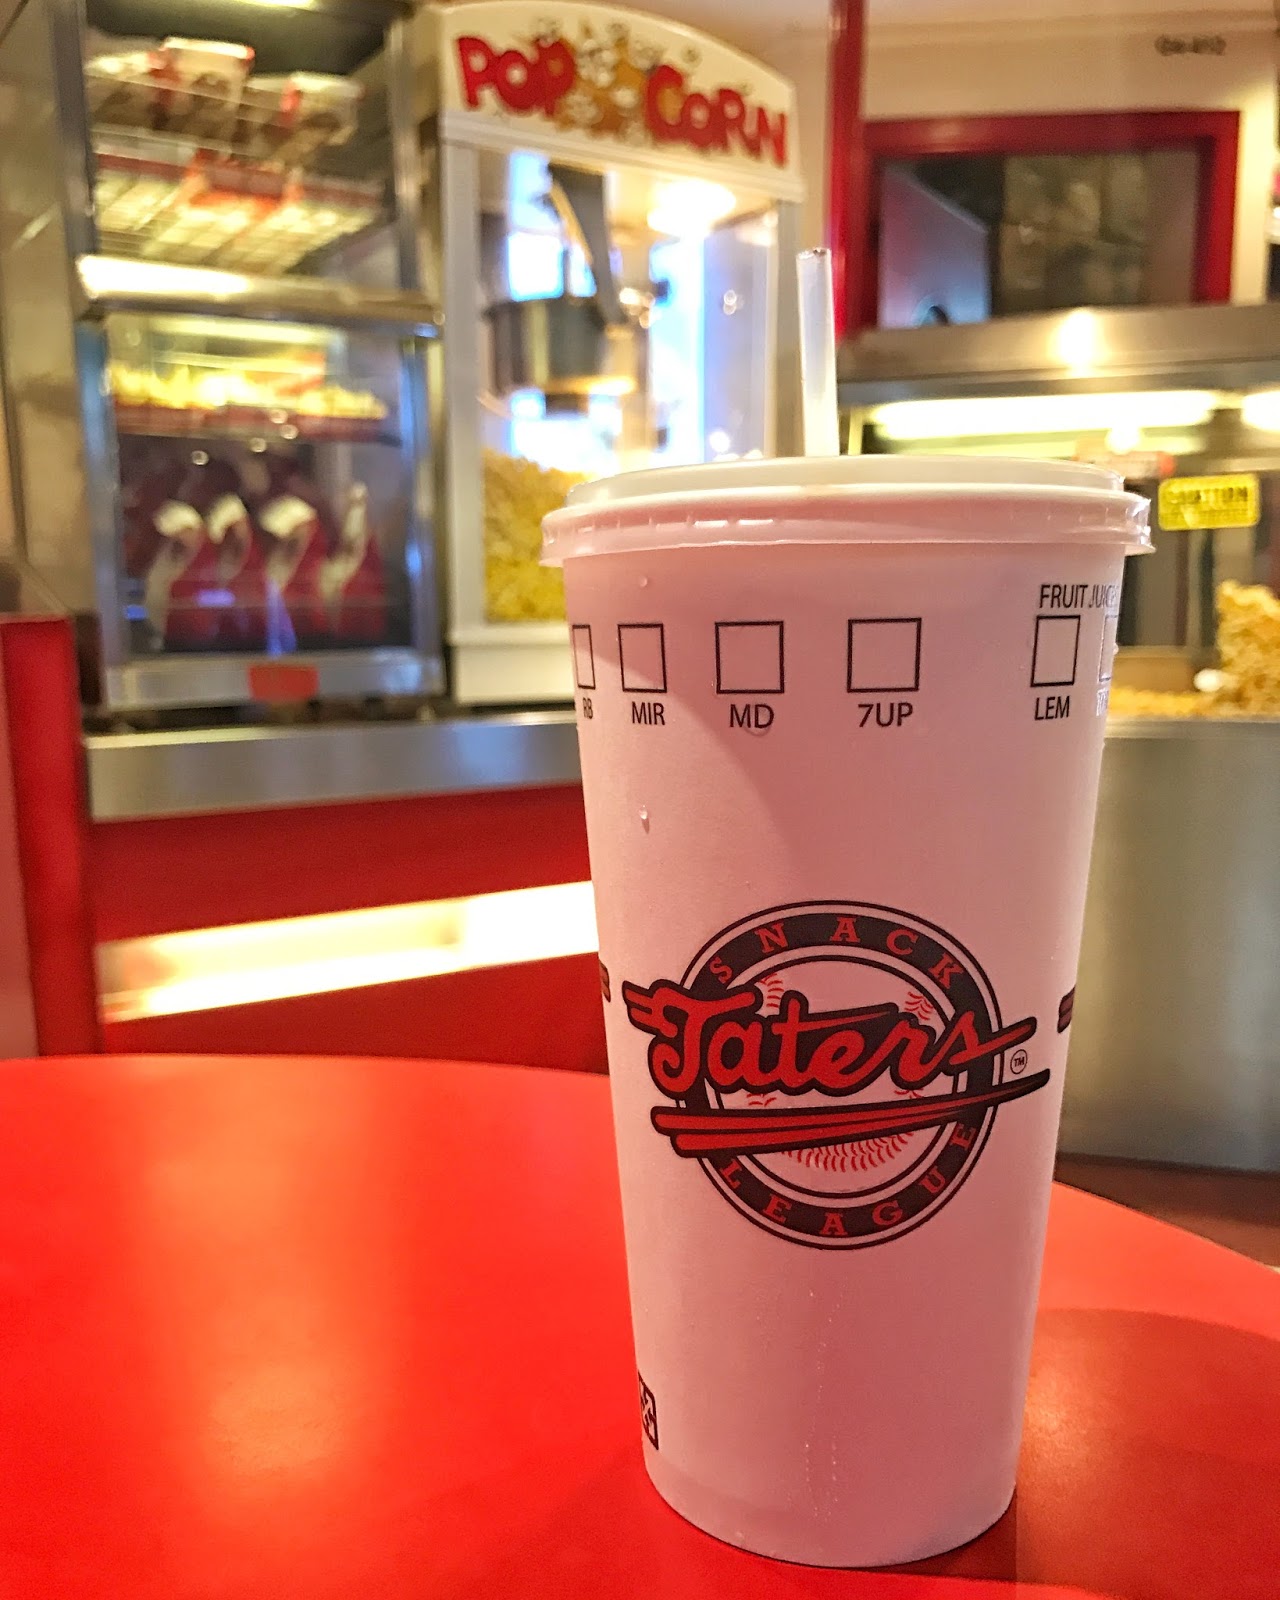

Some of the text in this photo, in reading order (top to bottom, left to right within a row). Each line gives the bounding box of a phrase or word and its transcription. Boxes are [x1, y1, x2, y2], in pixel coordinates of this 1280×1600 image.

[456, 36, 789, 170] POP CORN
[1038, 583, 1089, 609] FRUIT
[631, 701, 666, 726] MIR
[729, 703, 775, 729] MD
[857, 702, 914, 728] 7UP
[1034, 695, 1071, 721] LEM
[707, 916, 965, 990] SNACK
[624, 980, 1037, 1097] Taters
[718, 1123, 977, 1237] LEAGUE
